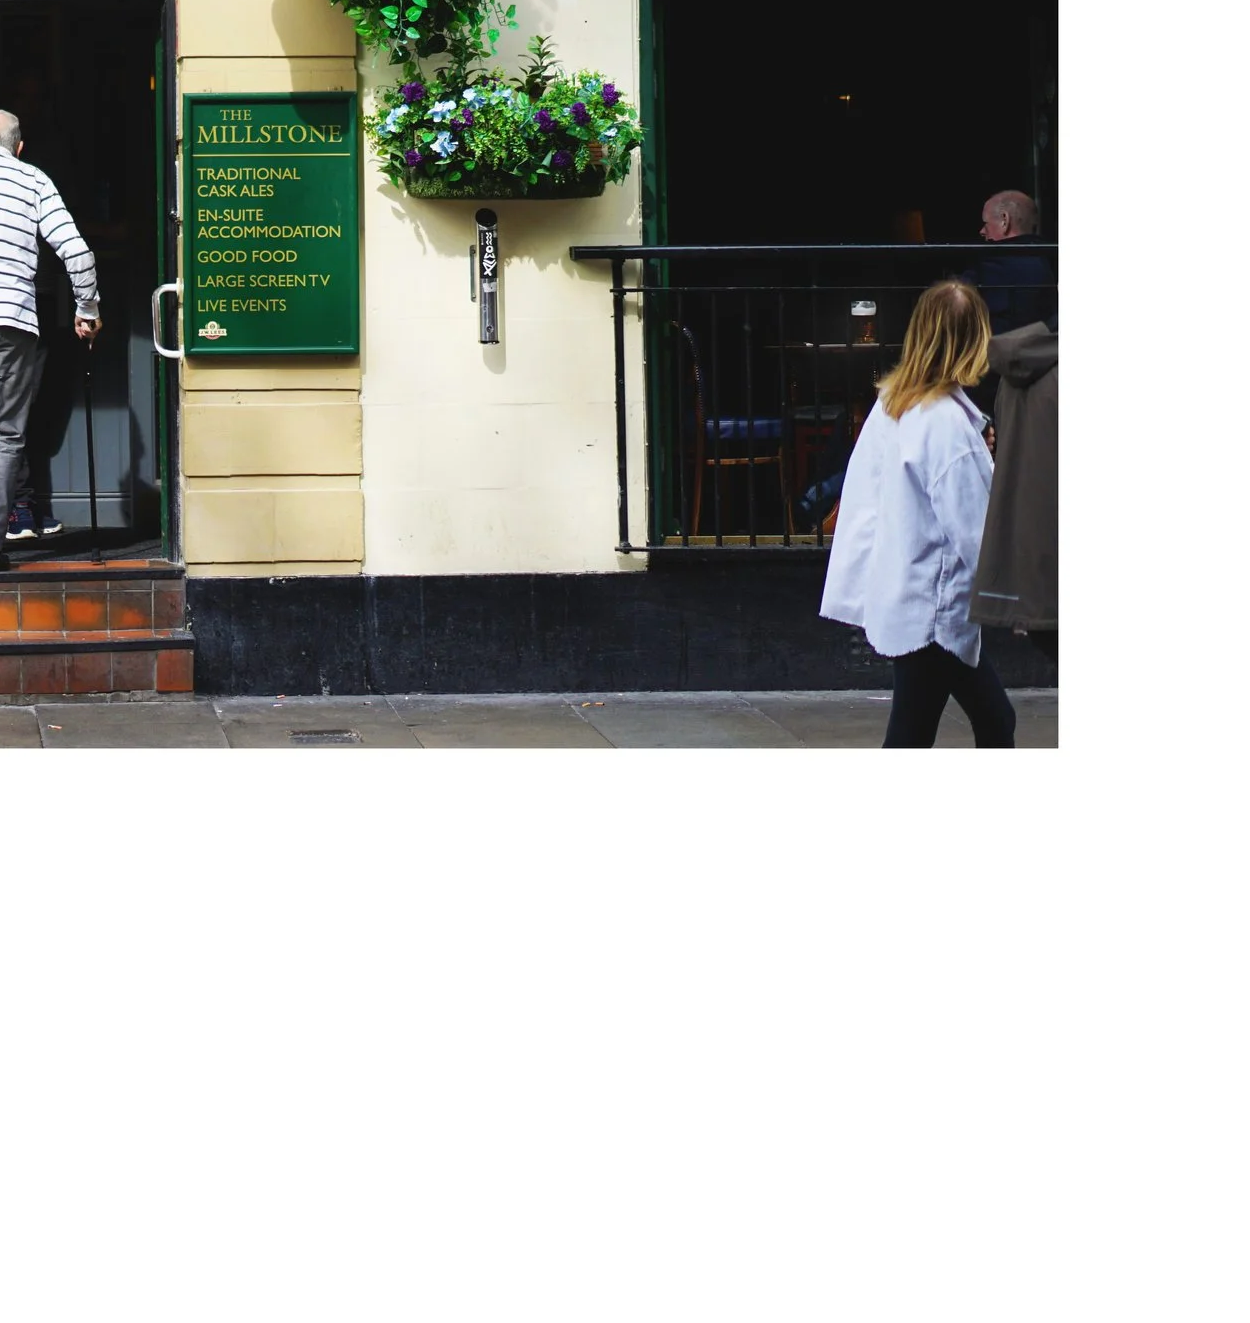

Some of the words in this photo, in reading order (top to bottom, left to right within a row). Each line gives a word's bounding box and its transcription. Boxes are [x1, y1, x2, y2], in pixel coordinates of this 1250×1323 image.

[220, 109, 252, 121] THE
[196, 124, 343, 144] MILLSTONE
[197, 167, 301, 180] TRADITIONAL
[197, 184, 238, 197] CASK
[239, 184, 274, 197] ALES
[198, 208, 264, 222] EN-SUITE
[197, 225, 341, 238] ACCOMMODATION
[197, 250, 247, 263] GOOD
[252, 250, 298, 263] FOOD
[197, 275, 246, 288] LARGE
[250, 274, 306, 287] SCREEN
[309, 274, 330, 287] TV
[197, 299, 227, 312] LIVE
[231, 299, 287, 312] EVENTS
